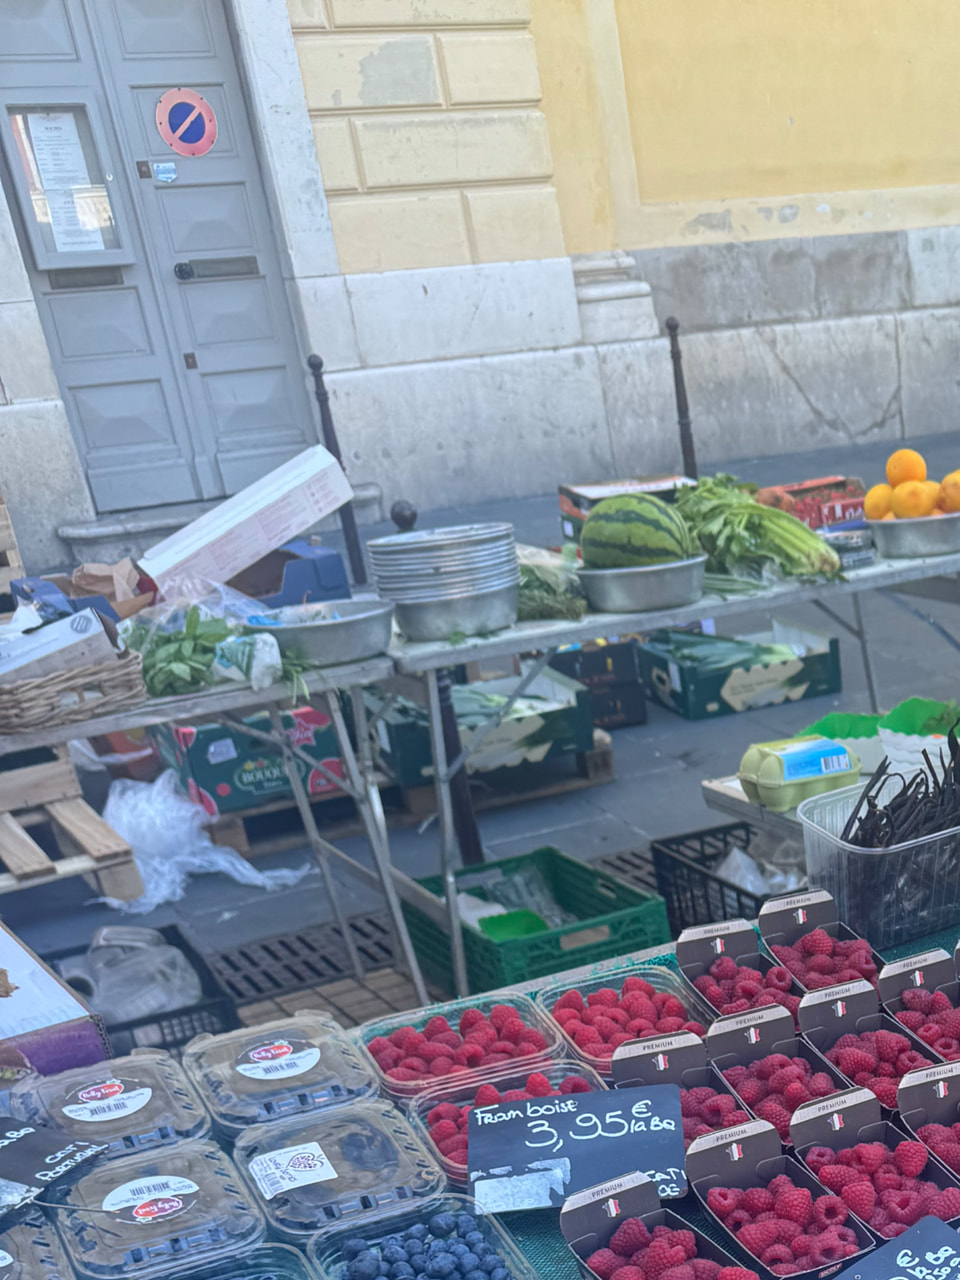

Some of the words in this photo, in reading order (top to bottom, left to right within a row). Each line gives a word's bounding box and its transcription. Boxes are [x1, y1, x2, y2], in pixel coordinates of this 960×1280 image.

[902, 956, 929, 969] PREMIUM
[824, 986, 851, 999] PREMIUM
[735, 1013, 764, 1026] PREMIUM
[642, 1039, 674, 1051] PREMIUM
[925, 1067, 954, 1079] PREMIUM
[817, 1098, 847, 1113] PREMIUM
[524, 1110, 629, 1153] 3,95
[631, 1099, 652, 1118] €
[715, 1128, 747, 1142] PREMIUM
[591, 1181, 624, 1199] PREMIUM
[896, 1248, 920, 1268] €
